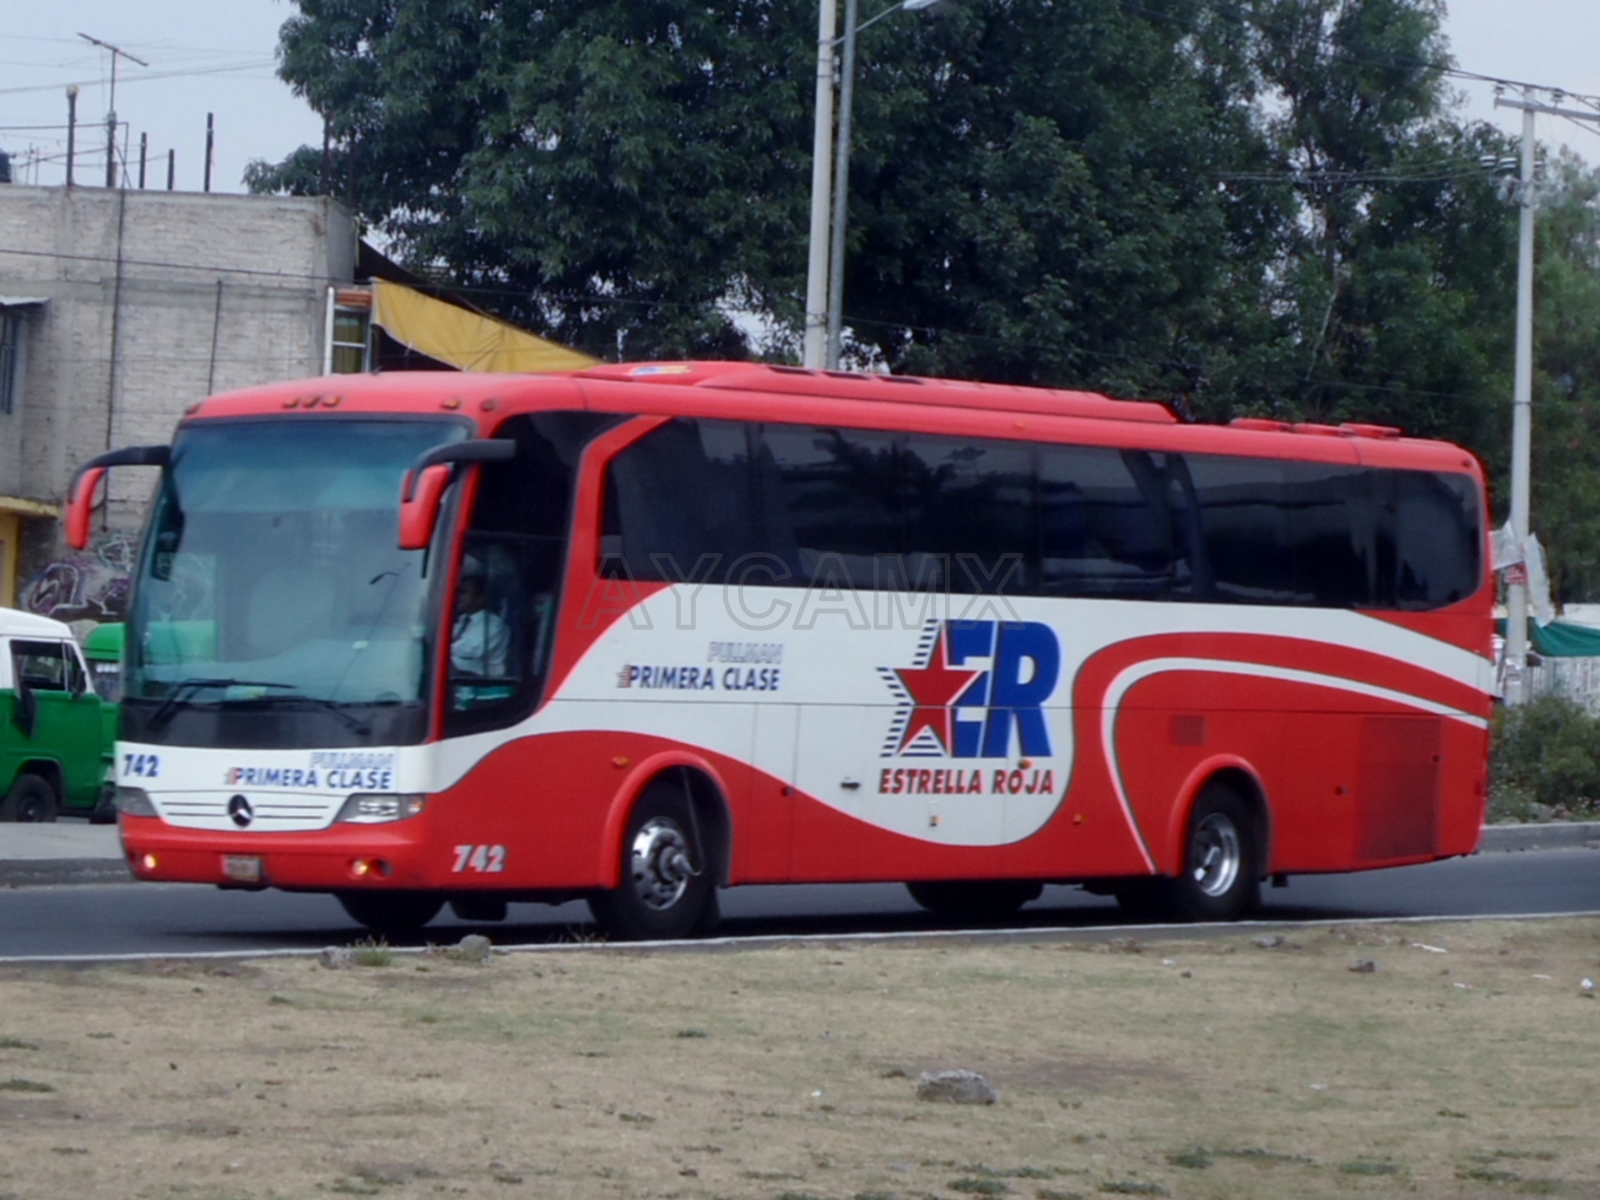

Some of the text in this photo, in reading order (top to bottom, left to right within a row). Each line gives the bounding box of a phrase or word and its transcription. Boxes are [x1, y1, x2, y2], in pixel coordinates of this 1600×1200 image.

[629, 665, 780, 691] PRIMERA CLASE
[123, 754, 159, 777] 742
[232, 767, 391, 789] PRIMERA CLASE
[878, 768, 1055, 795] ESTRELLA ROJA
[451, 844, 507, 873] 742
